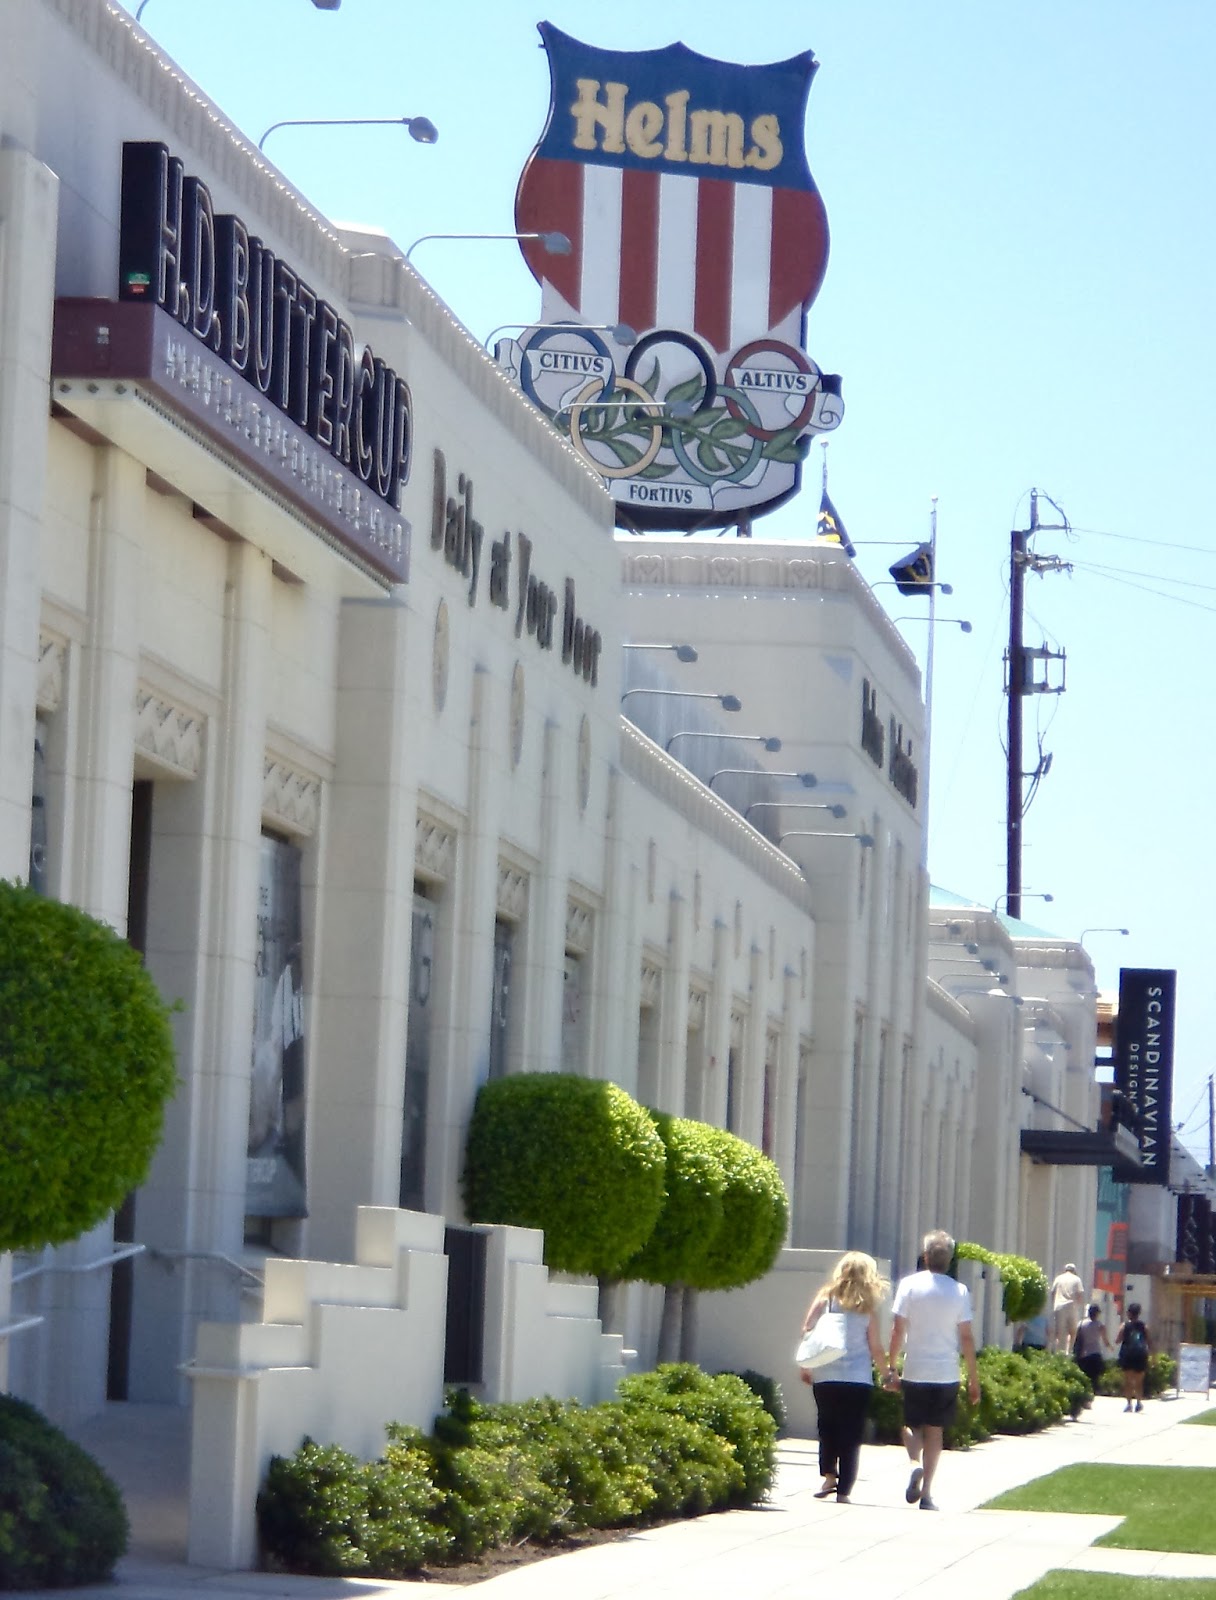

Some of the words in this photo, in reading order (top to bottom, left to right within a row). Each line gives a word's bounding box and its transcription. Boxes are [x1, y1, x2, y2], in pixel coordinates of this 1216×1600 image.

[571, 79, 784, 171] Helms
[224, 215, 413, 511] BUTTERCUP
[540, 352, 605, 374] CITIVS
[741, 373, 808, 391] ALTIVS
[629, 485, 694, 505] FORTIVS
[1142, 987, 1163, 1166] SCANDINAVIAN
